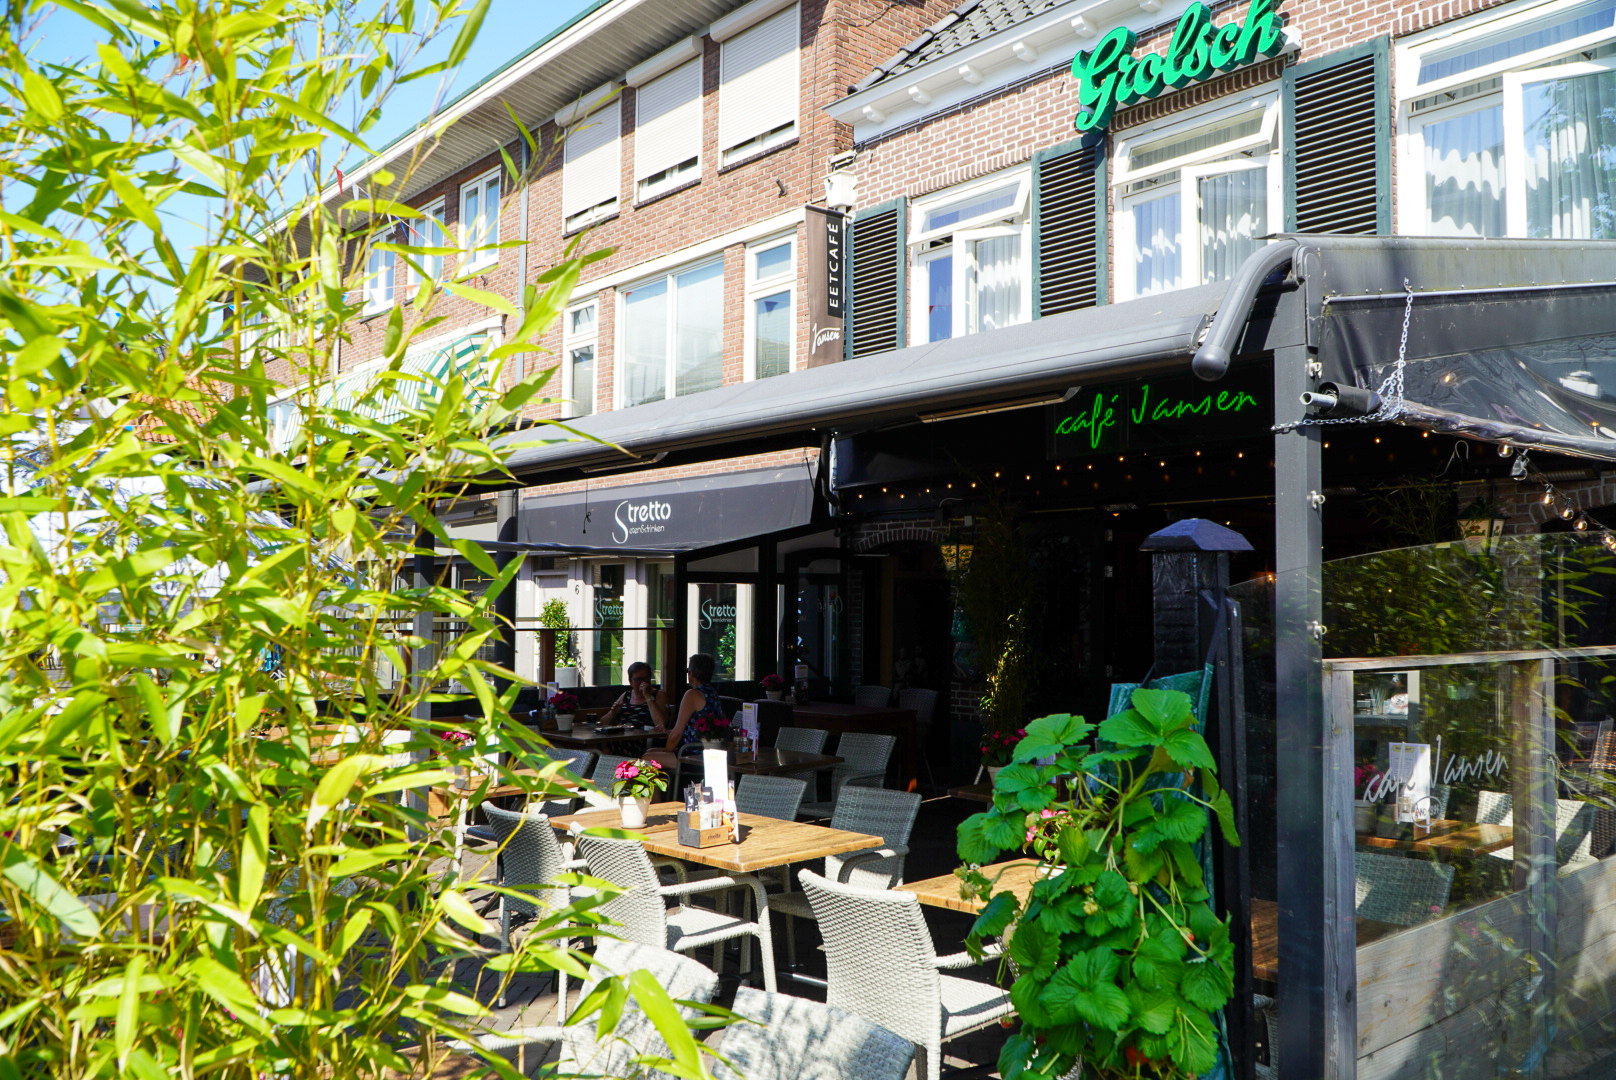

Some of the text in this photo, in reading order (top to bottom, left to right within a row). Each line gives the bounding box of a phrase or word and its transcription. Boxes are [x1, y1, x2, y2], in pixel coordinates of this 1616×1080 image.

[1072, 0, 1281, 131] Grolsch
[827, 223, 839, 308] EETCAFÉ
[812, 323, 841, 355] Jansen
[1056, 384, 1257, 448] café Jansen
[612, 500, 671, 544] Stretto
[700, 598, 737, 630] Stretto
[1430, 734, 1509, 789] Jansen
